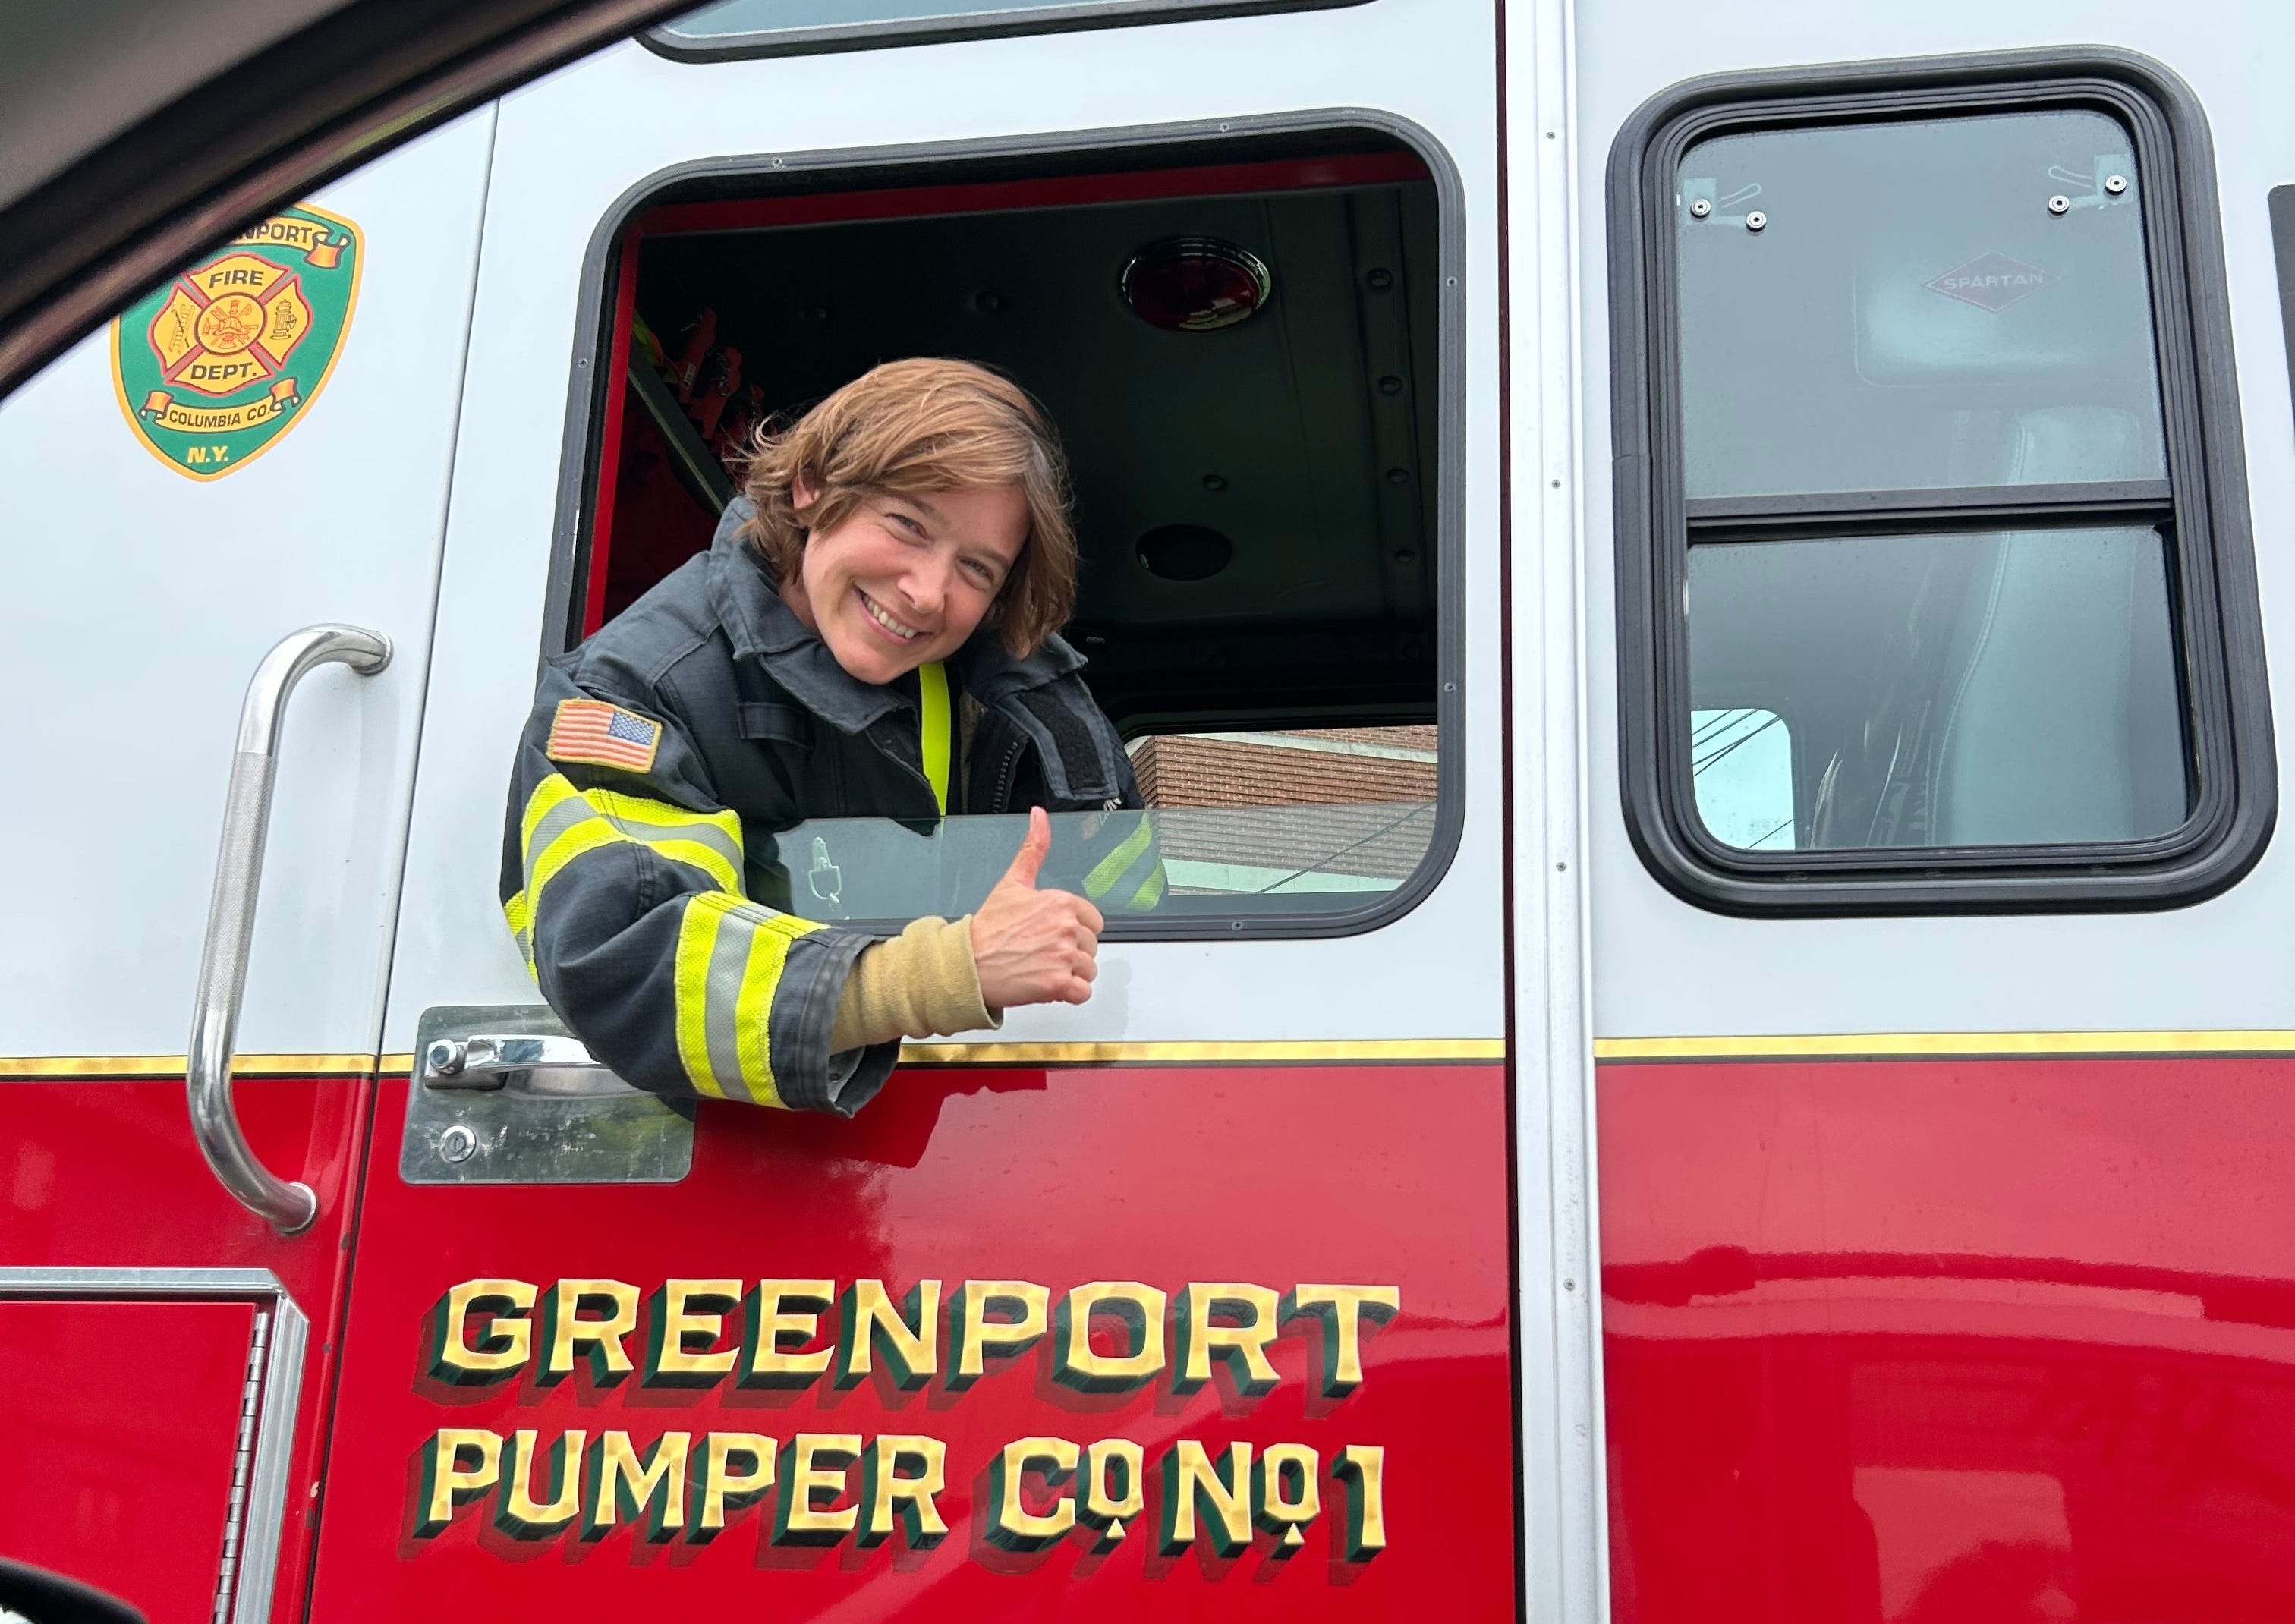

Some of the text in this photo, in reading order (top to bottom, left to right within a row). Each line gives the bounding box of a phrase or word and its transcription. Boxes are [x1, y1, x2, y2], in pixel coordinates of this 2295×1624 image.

[209, 269, 264, 289] FIRE
[1944, 273, 2044, 291] SPARTAN
[190, 362, 257, 380] DEPT.
[169, 404, 271, 428] COLUMBIA CO.
[187, 445, 229, 464] N.Y.
[442, 1278, 1400, 1383] GREENPORT
[428, 1427, 949, 1534] PUMPER
[1346, 1443, 1387, 1547] 1
